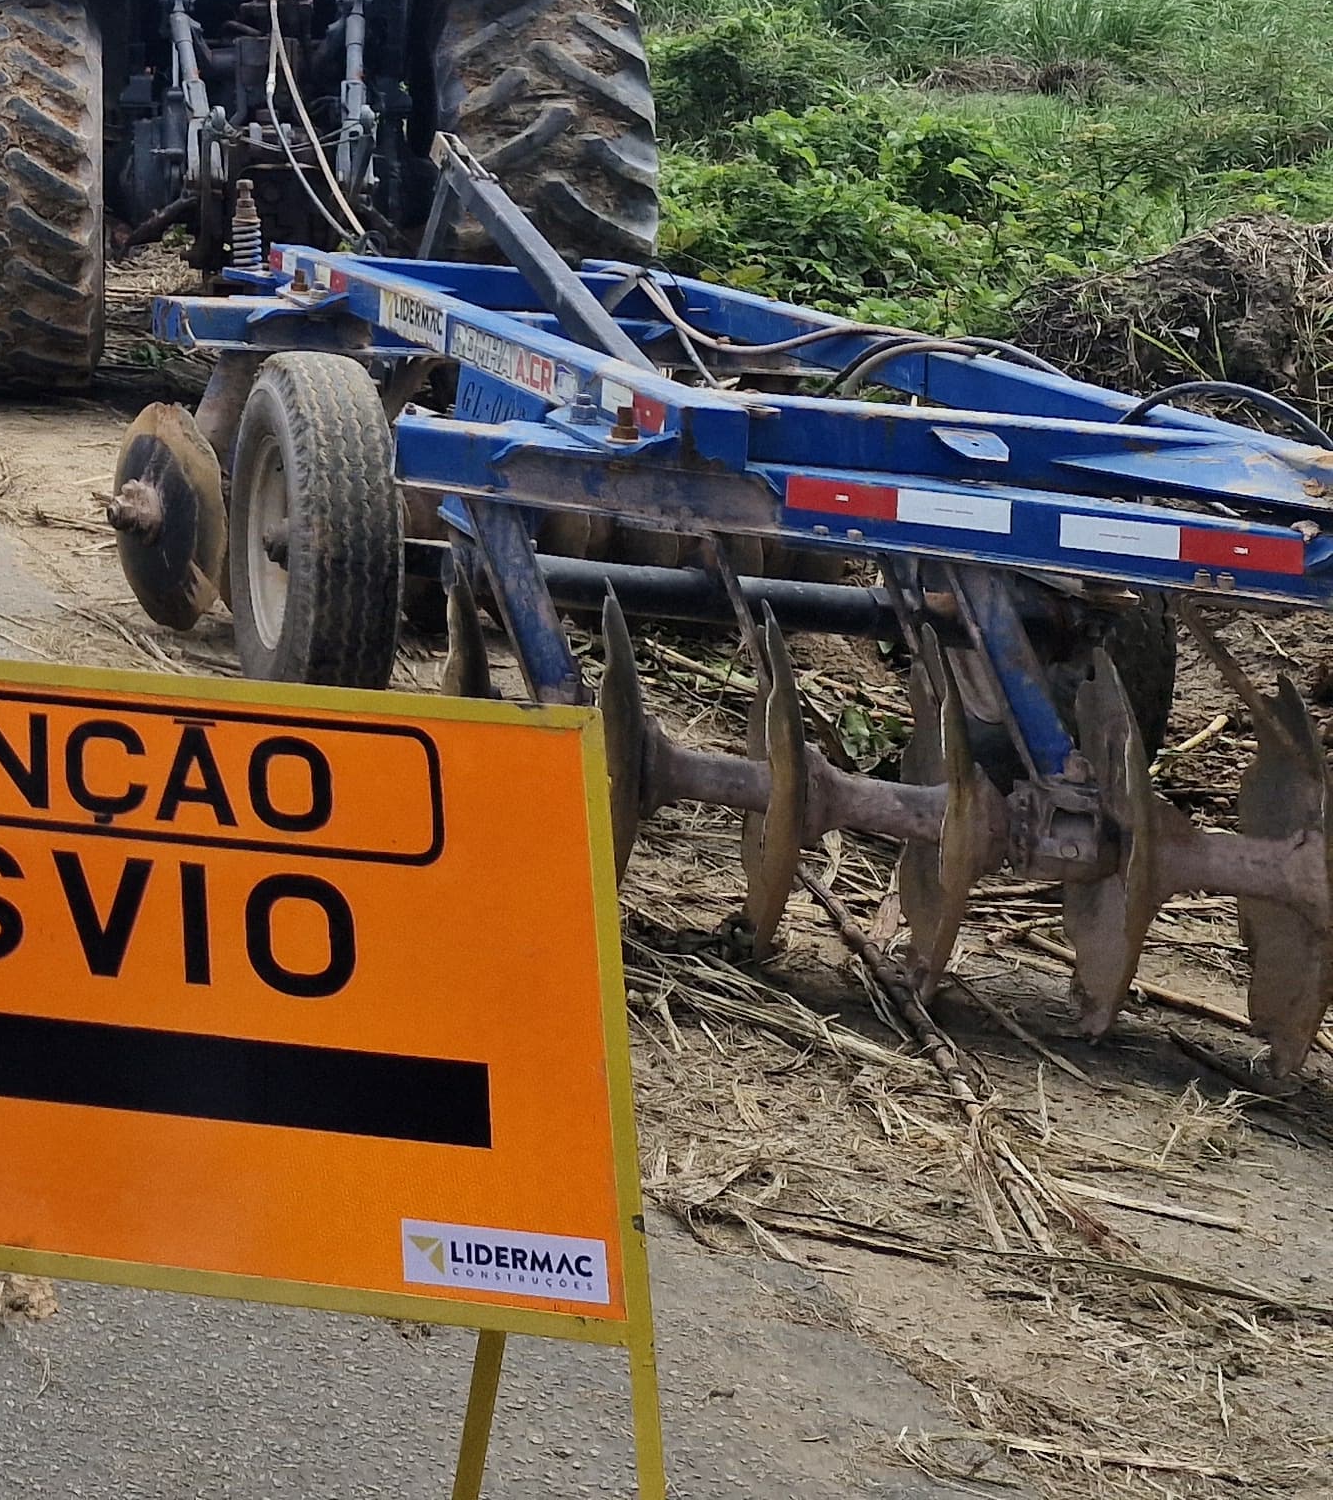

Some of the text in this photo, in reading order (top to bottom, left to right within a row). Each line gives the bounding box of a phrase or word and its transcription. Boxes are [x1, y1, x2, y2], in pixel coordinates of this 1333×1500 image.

[393, 293, 444, 337] LIDERMAC
[450, 1240, 594, 1278] LIDERMAC
[452, 1266, 593, 1292] CONSTRUÇÕES
